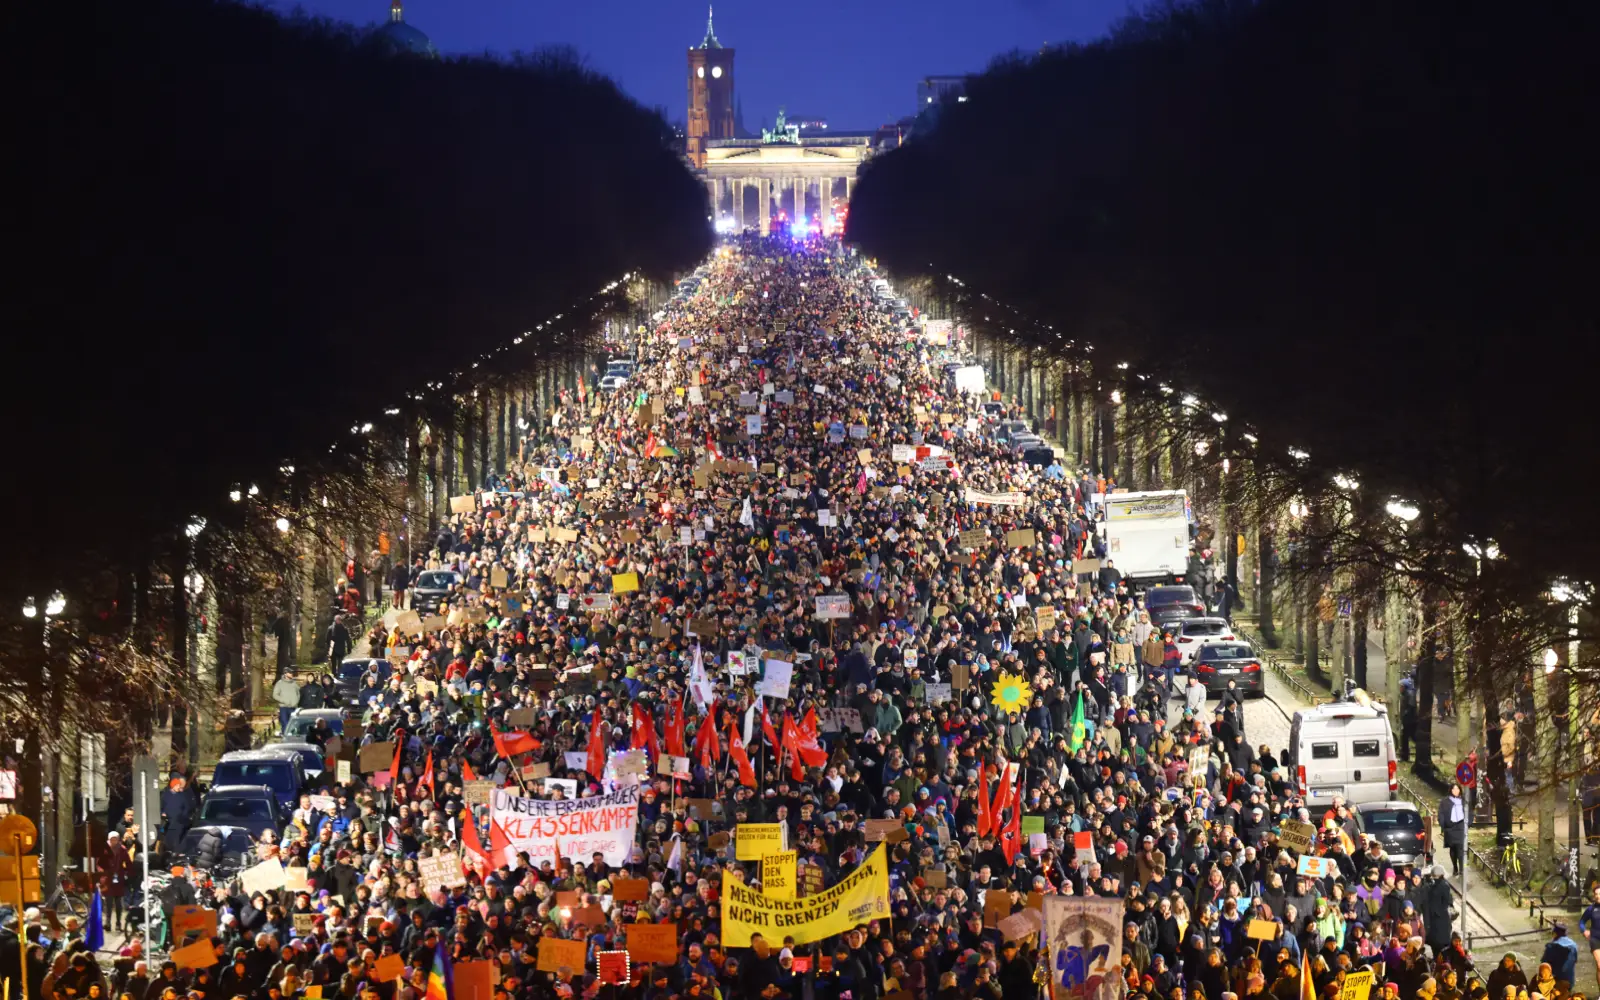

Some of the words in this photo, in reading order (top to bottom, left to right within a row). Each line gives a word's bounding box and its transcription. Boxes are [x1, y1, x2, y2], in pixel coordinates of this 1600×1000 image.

[494, 788, 550, 817] UNSERE
[503, 806, 637, 840] KLASSENKAMPF
[764, 853, 796, 866] STOPPT
[764, 866, 781, 877] DEN
[764, 878, 788, 888] HASS.
[730, 885, 803, 911] MENSCHEN
[729, 905, 769, 926] NICHT
[775, 899, 840, 927] GRENZEN
[1346, 974, 1371, 989] STOPPT
[1344, 989, 1357, 1000] DEN
